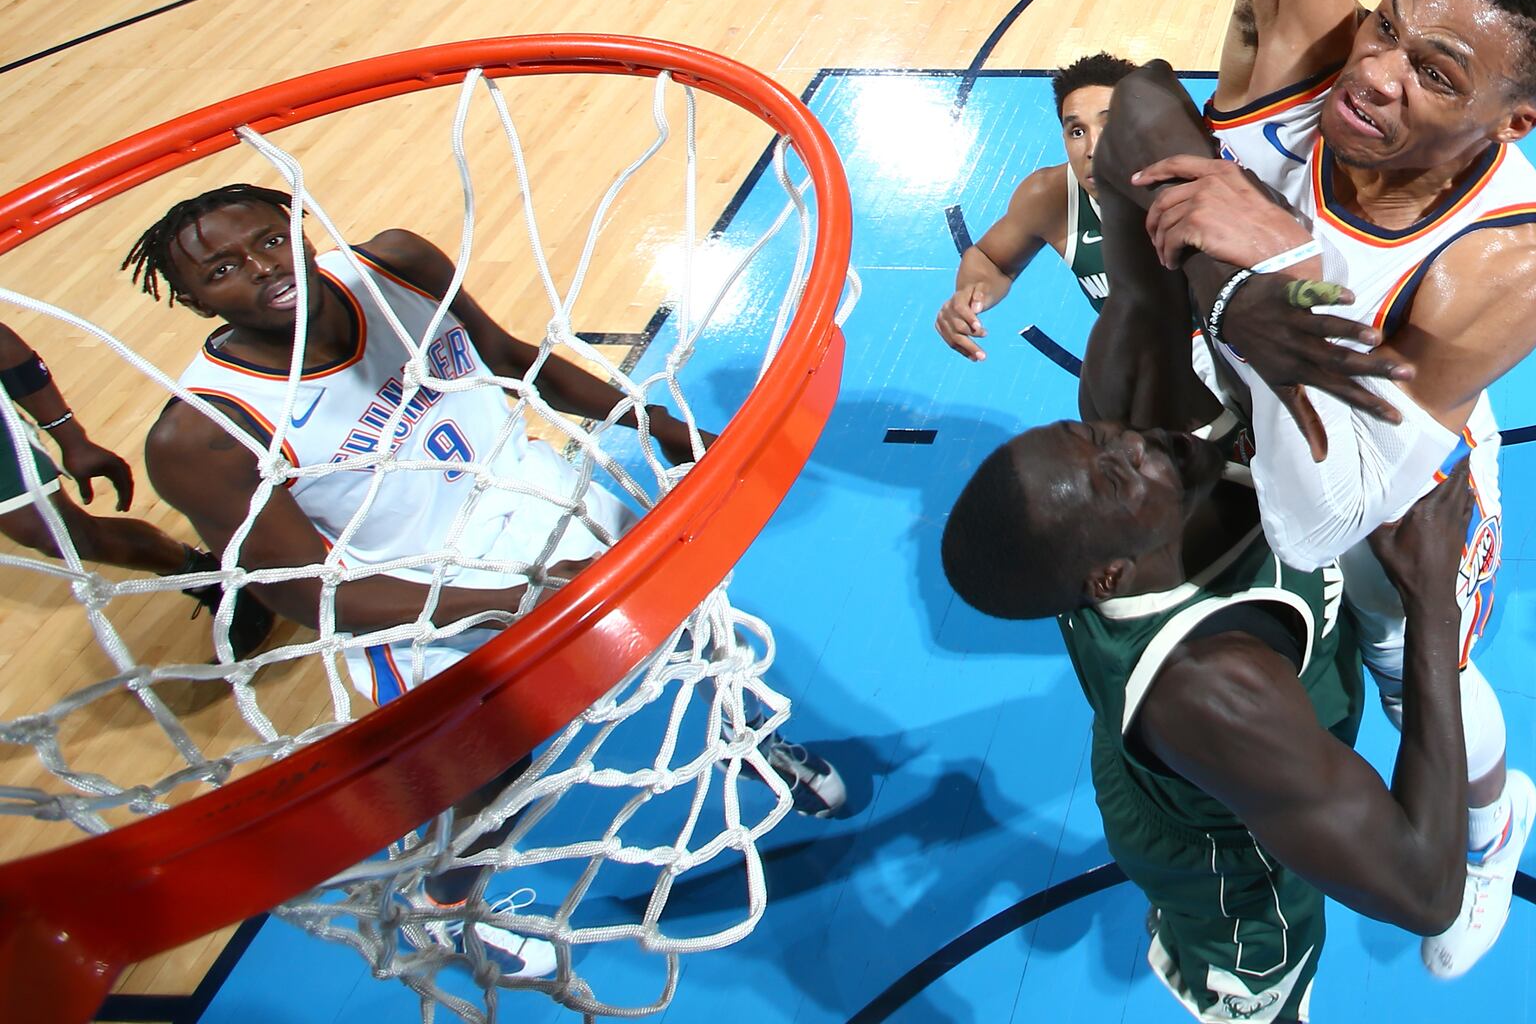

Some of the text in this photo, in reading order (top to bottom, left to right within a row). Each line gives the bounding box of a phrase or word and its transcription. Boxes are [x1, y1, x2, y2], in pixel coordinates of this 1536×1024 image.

[1220, 269, 1252, 300] Never
[1209, 299, 1225, 325] Give
[423, 419, 476, 483] 9
